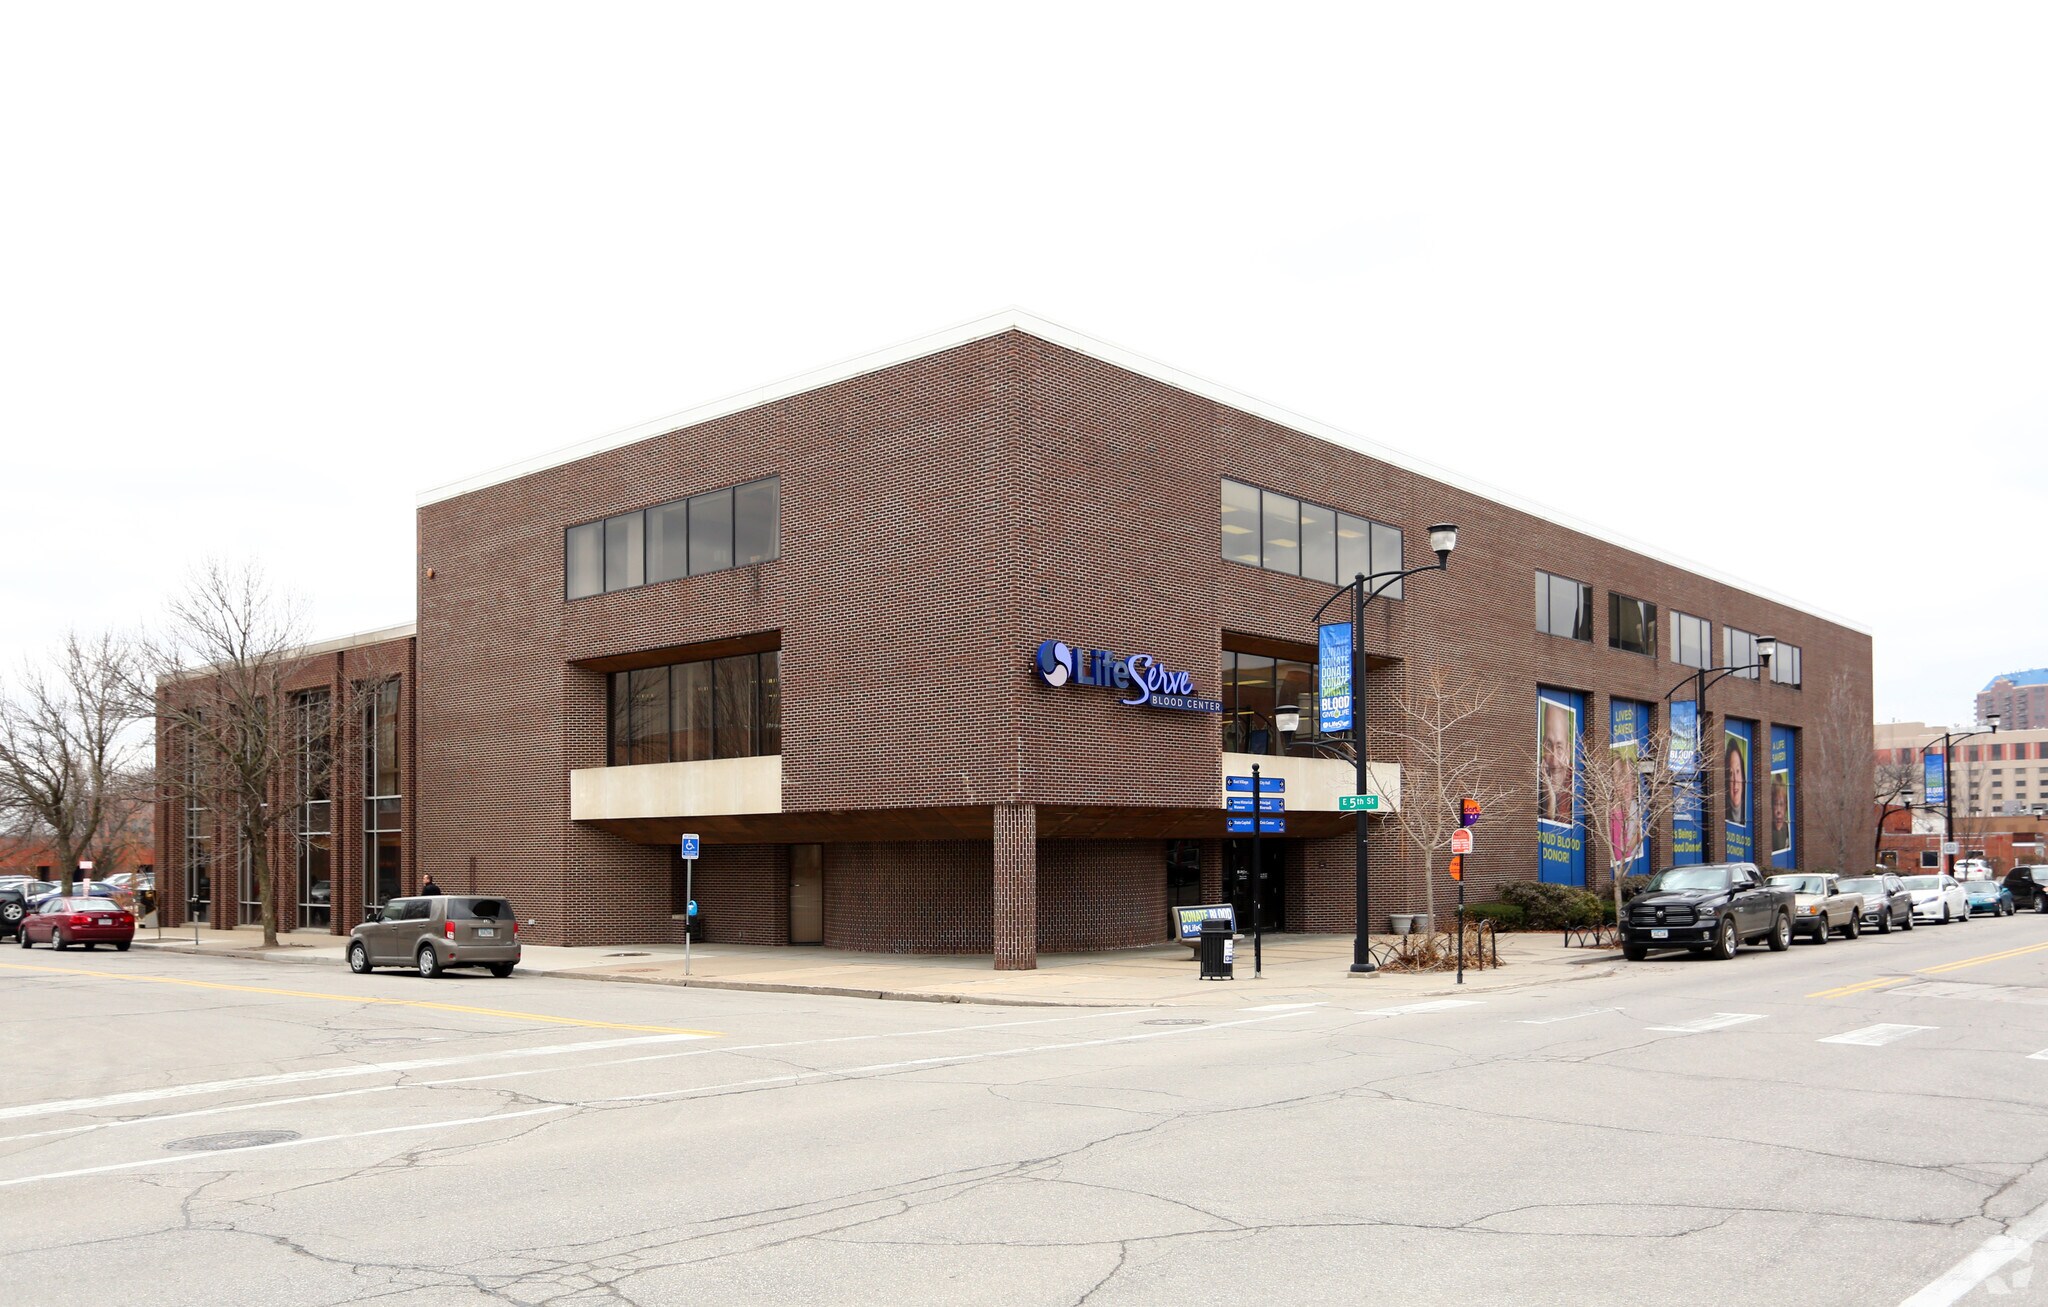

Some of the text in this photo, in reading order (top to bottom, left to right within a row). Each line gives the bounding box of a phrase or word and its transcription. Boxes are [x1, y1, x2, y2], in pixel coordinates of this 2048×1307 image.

[1321, 656, 1349, 668] DONATE
[1072, 647, 1193, 705] LifeServe
[1321, 666, 1349, 678] DONATE
[1321, 676, 1349, 688] DONATE
[1321, 685, 1349, 698] DONATE
[1151, 695, 1221, 711] BLOOD CENTER
[1321, 696, 1350, 711] BLOOD
[1615, 709, 1632, 722] LIVES
[1342, 797, 1375, 808] E 5th St
[1557, 836, 1580, 851] BLOOD
[1181, 910, 1208, 923] DONATE
